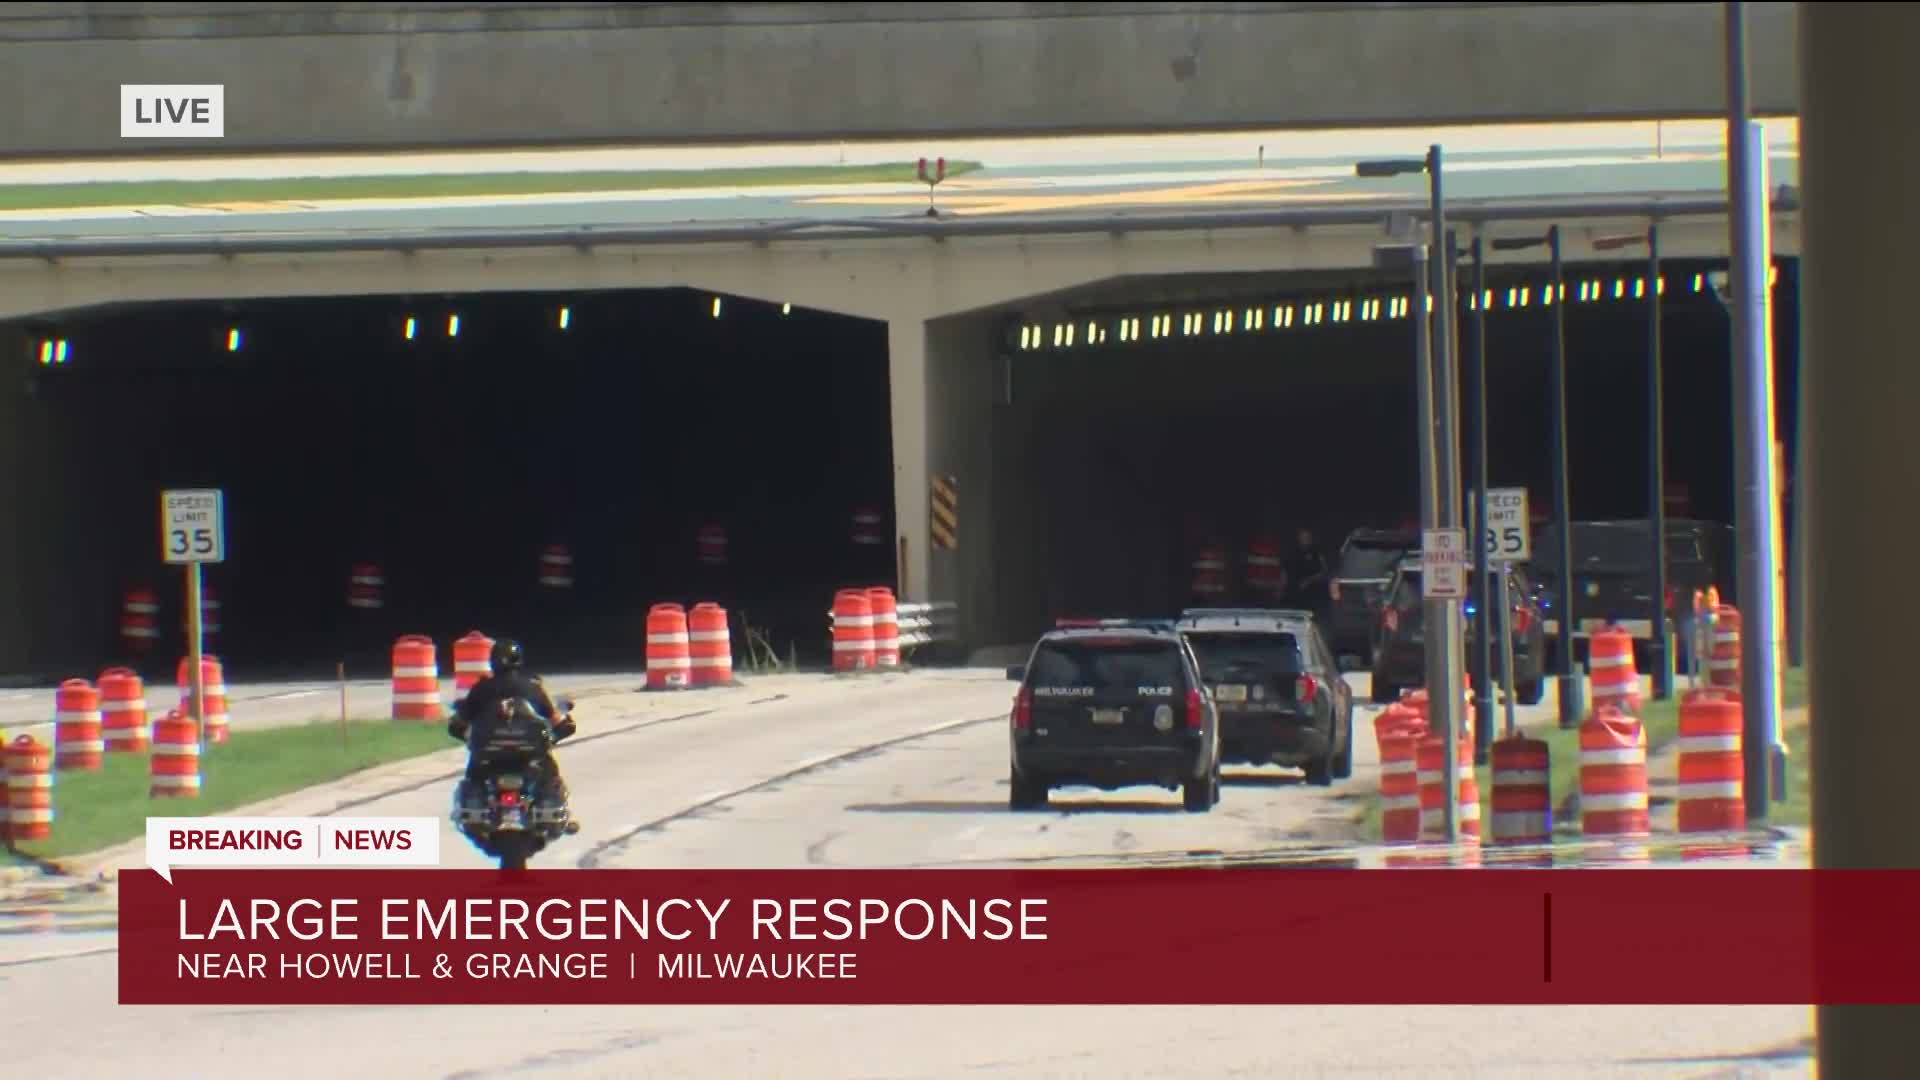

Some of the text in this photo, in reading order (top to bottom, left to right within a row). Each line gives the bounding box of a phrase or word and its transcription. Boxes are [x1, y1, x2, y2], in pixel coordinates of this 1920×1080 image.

[173, 512, 208, 523] LIMIT
[1488, 510, 1516, 521] IMIT
[169, 528, 213, 555] 35
[1034, 686, 1173, 697] MILWAUKEE POLICE
